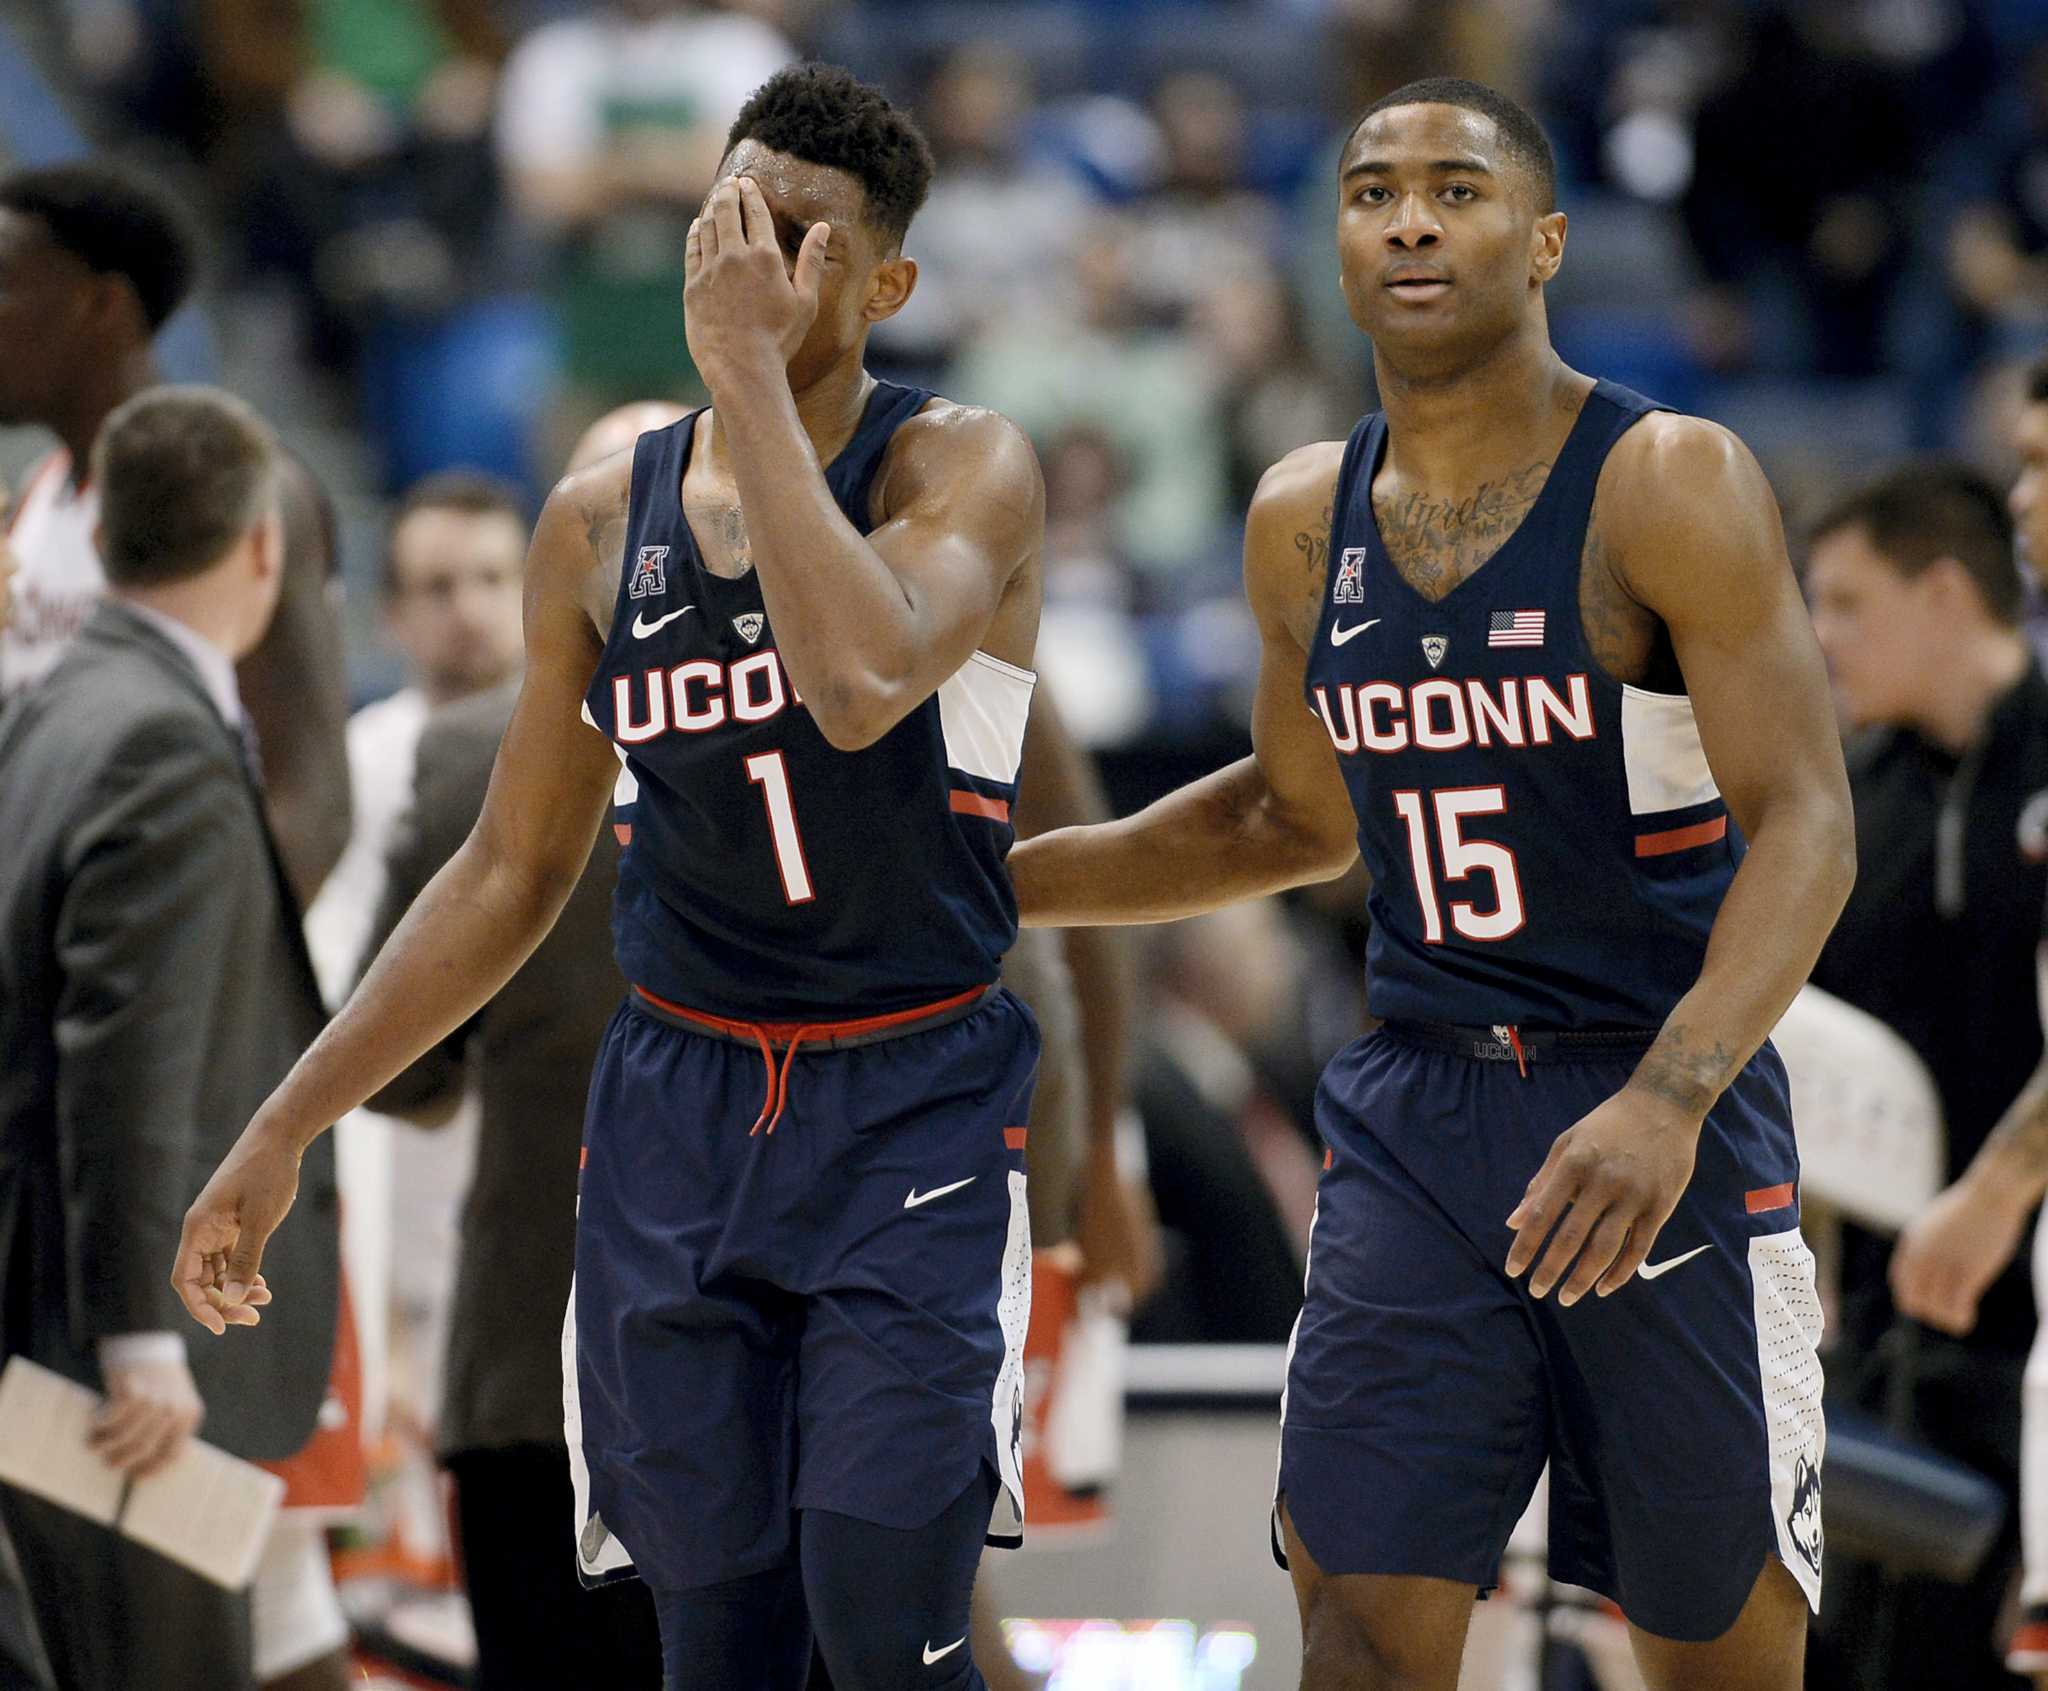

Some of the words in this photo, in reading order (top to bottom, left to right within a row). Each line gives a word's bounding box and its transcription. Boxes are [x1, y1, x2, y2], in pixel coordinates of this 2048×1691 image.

[612, 648, 802, 744] UCO
[1313, 673, 1597, 755] UCONN
[743, 749, 816, 906] 1
[1392, 784, 1527, 944] 15
